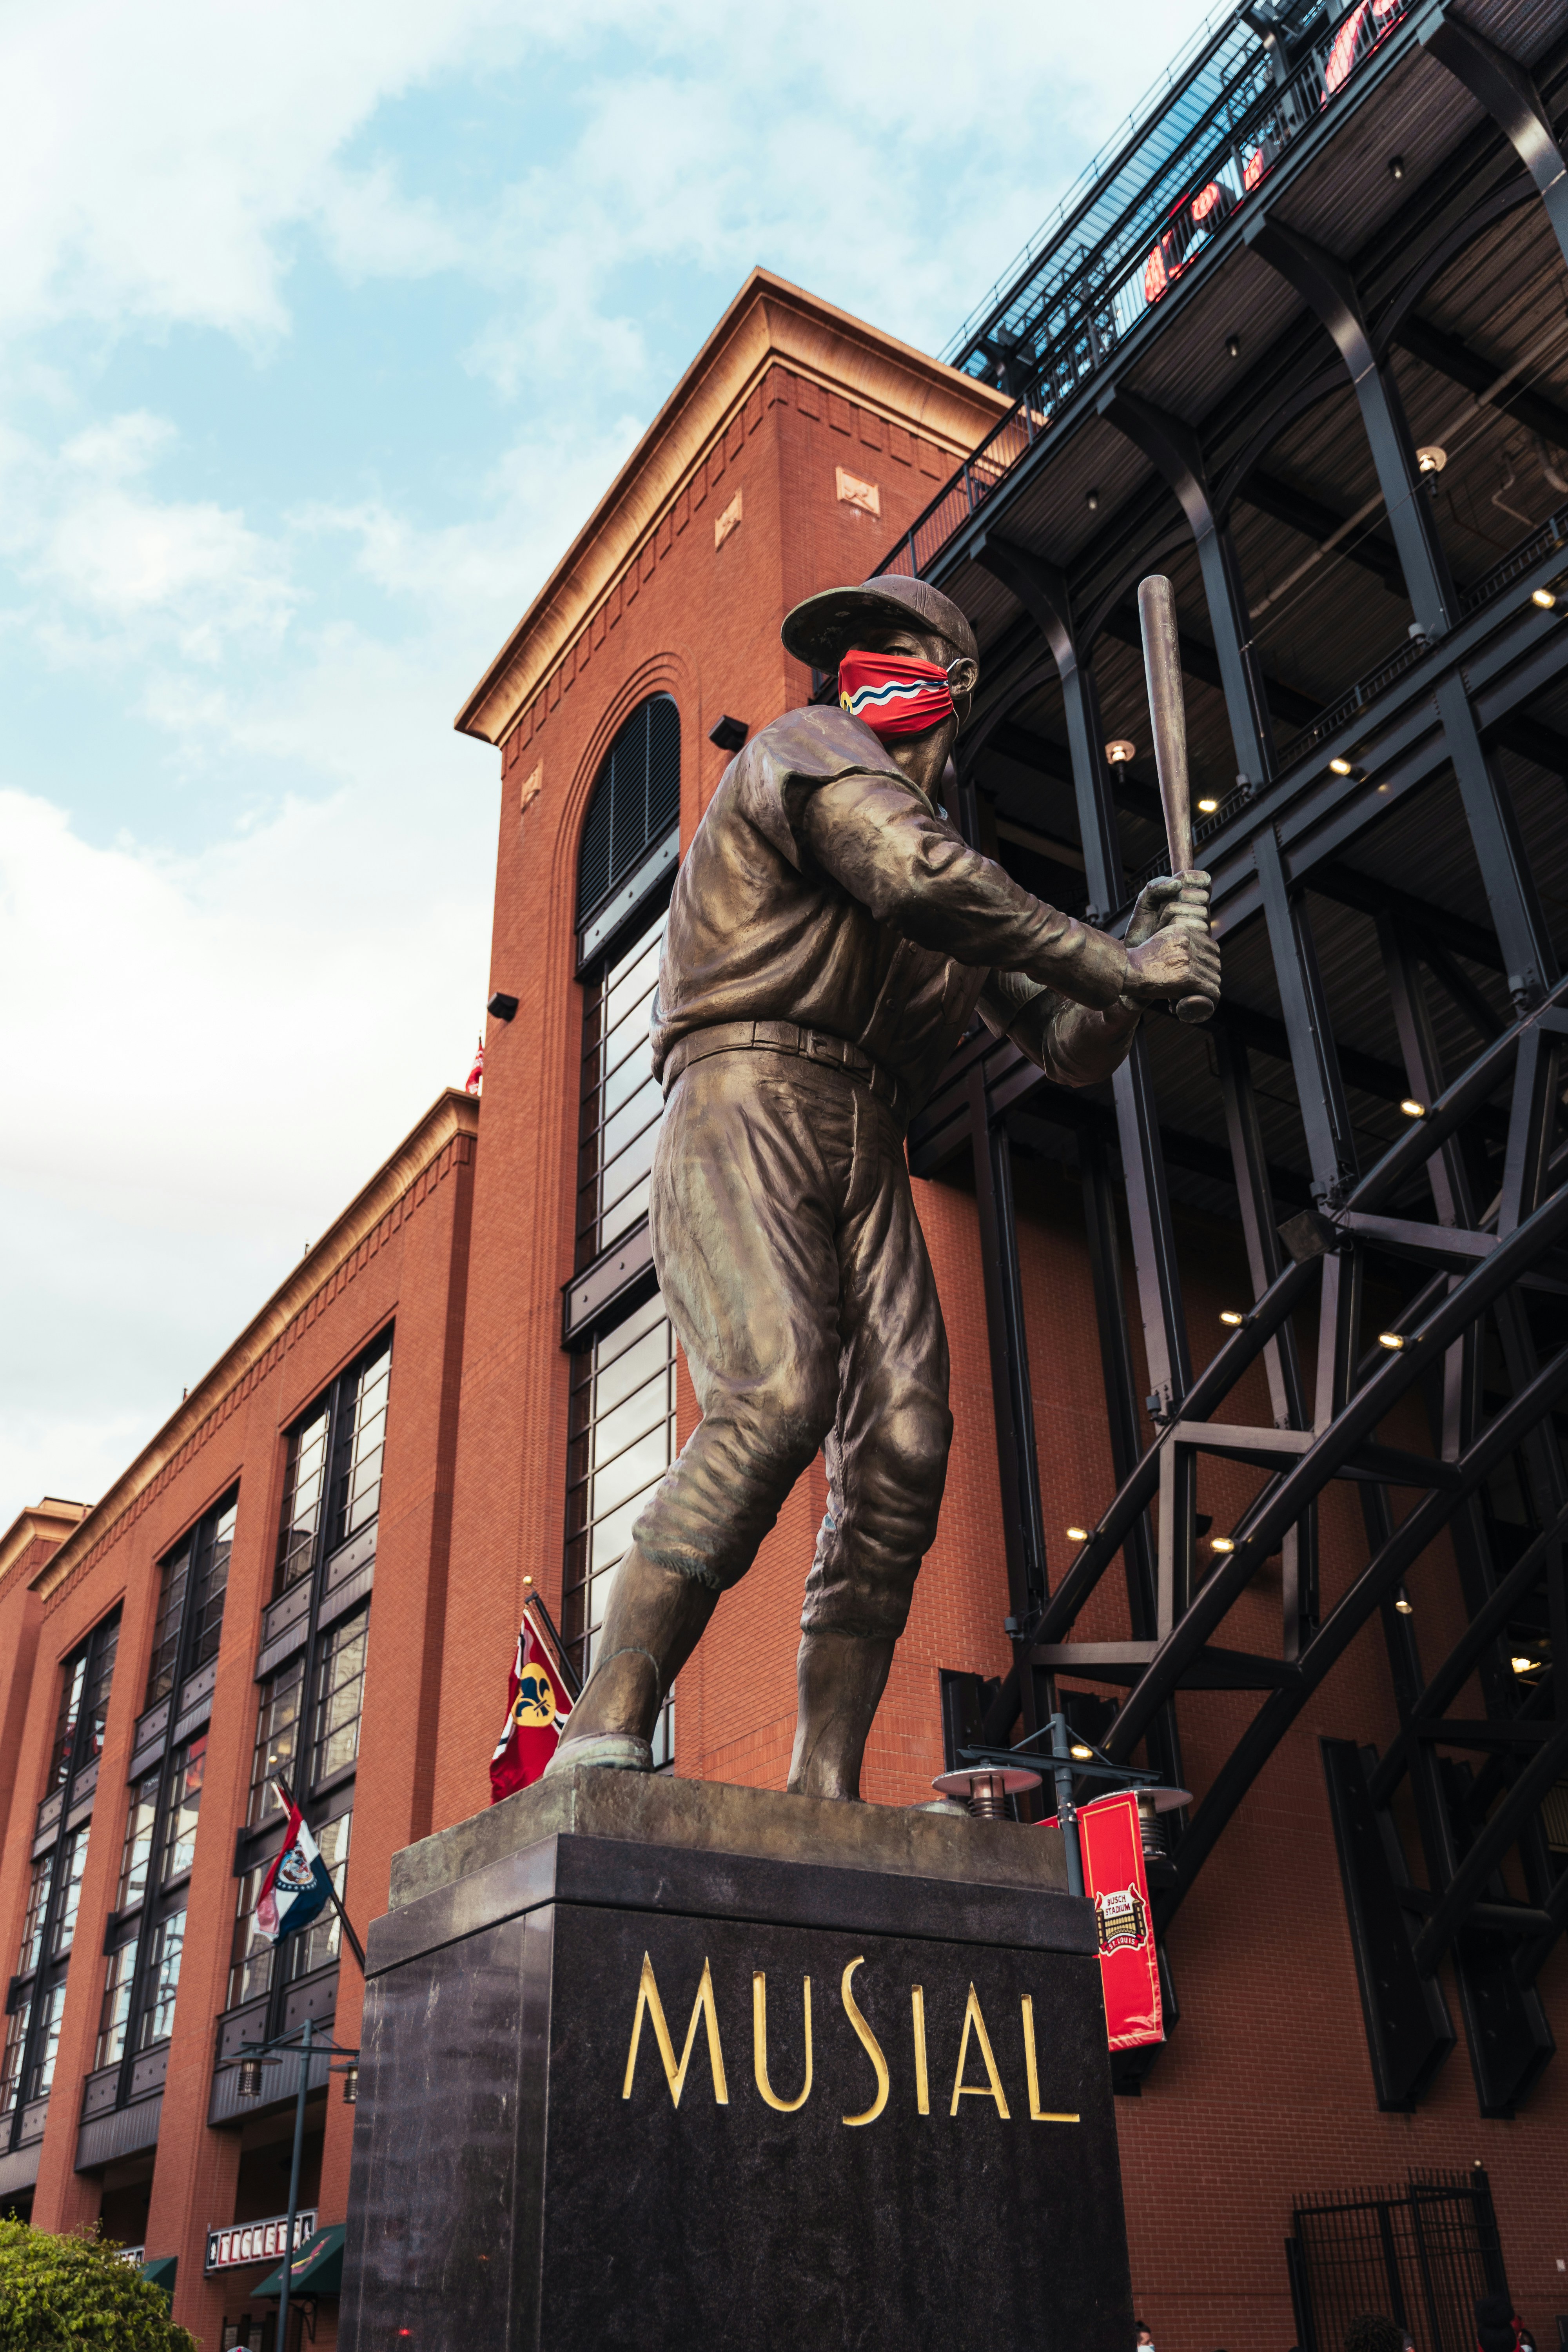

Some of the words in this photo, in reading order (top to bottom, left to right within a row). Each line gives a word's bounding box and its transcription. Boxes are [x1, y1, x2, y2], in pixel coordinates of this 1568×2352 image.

[1107, 1895, 1126, 1906] BUSCH
[1105, 1903, 1131, 1916] STADIUM
[1117, 1936, 1136, 1945] LOUIS
[621, 1949, 1081, 2127] MUSIAL
